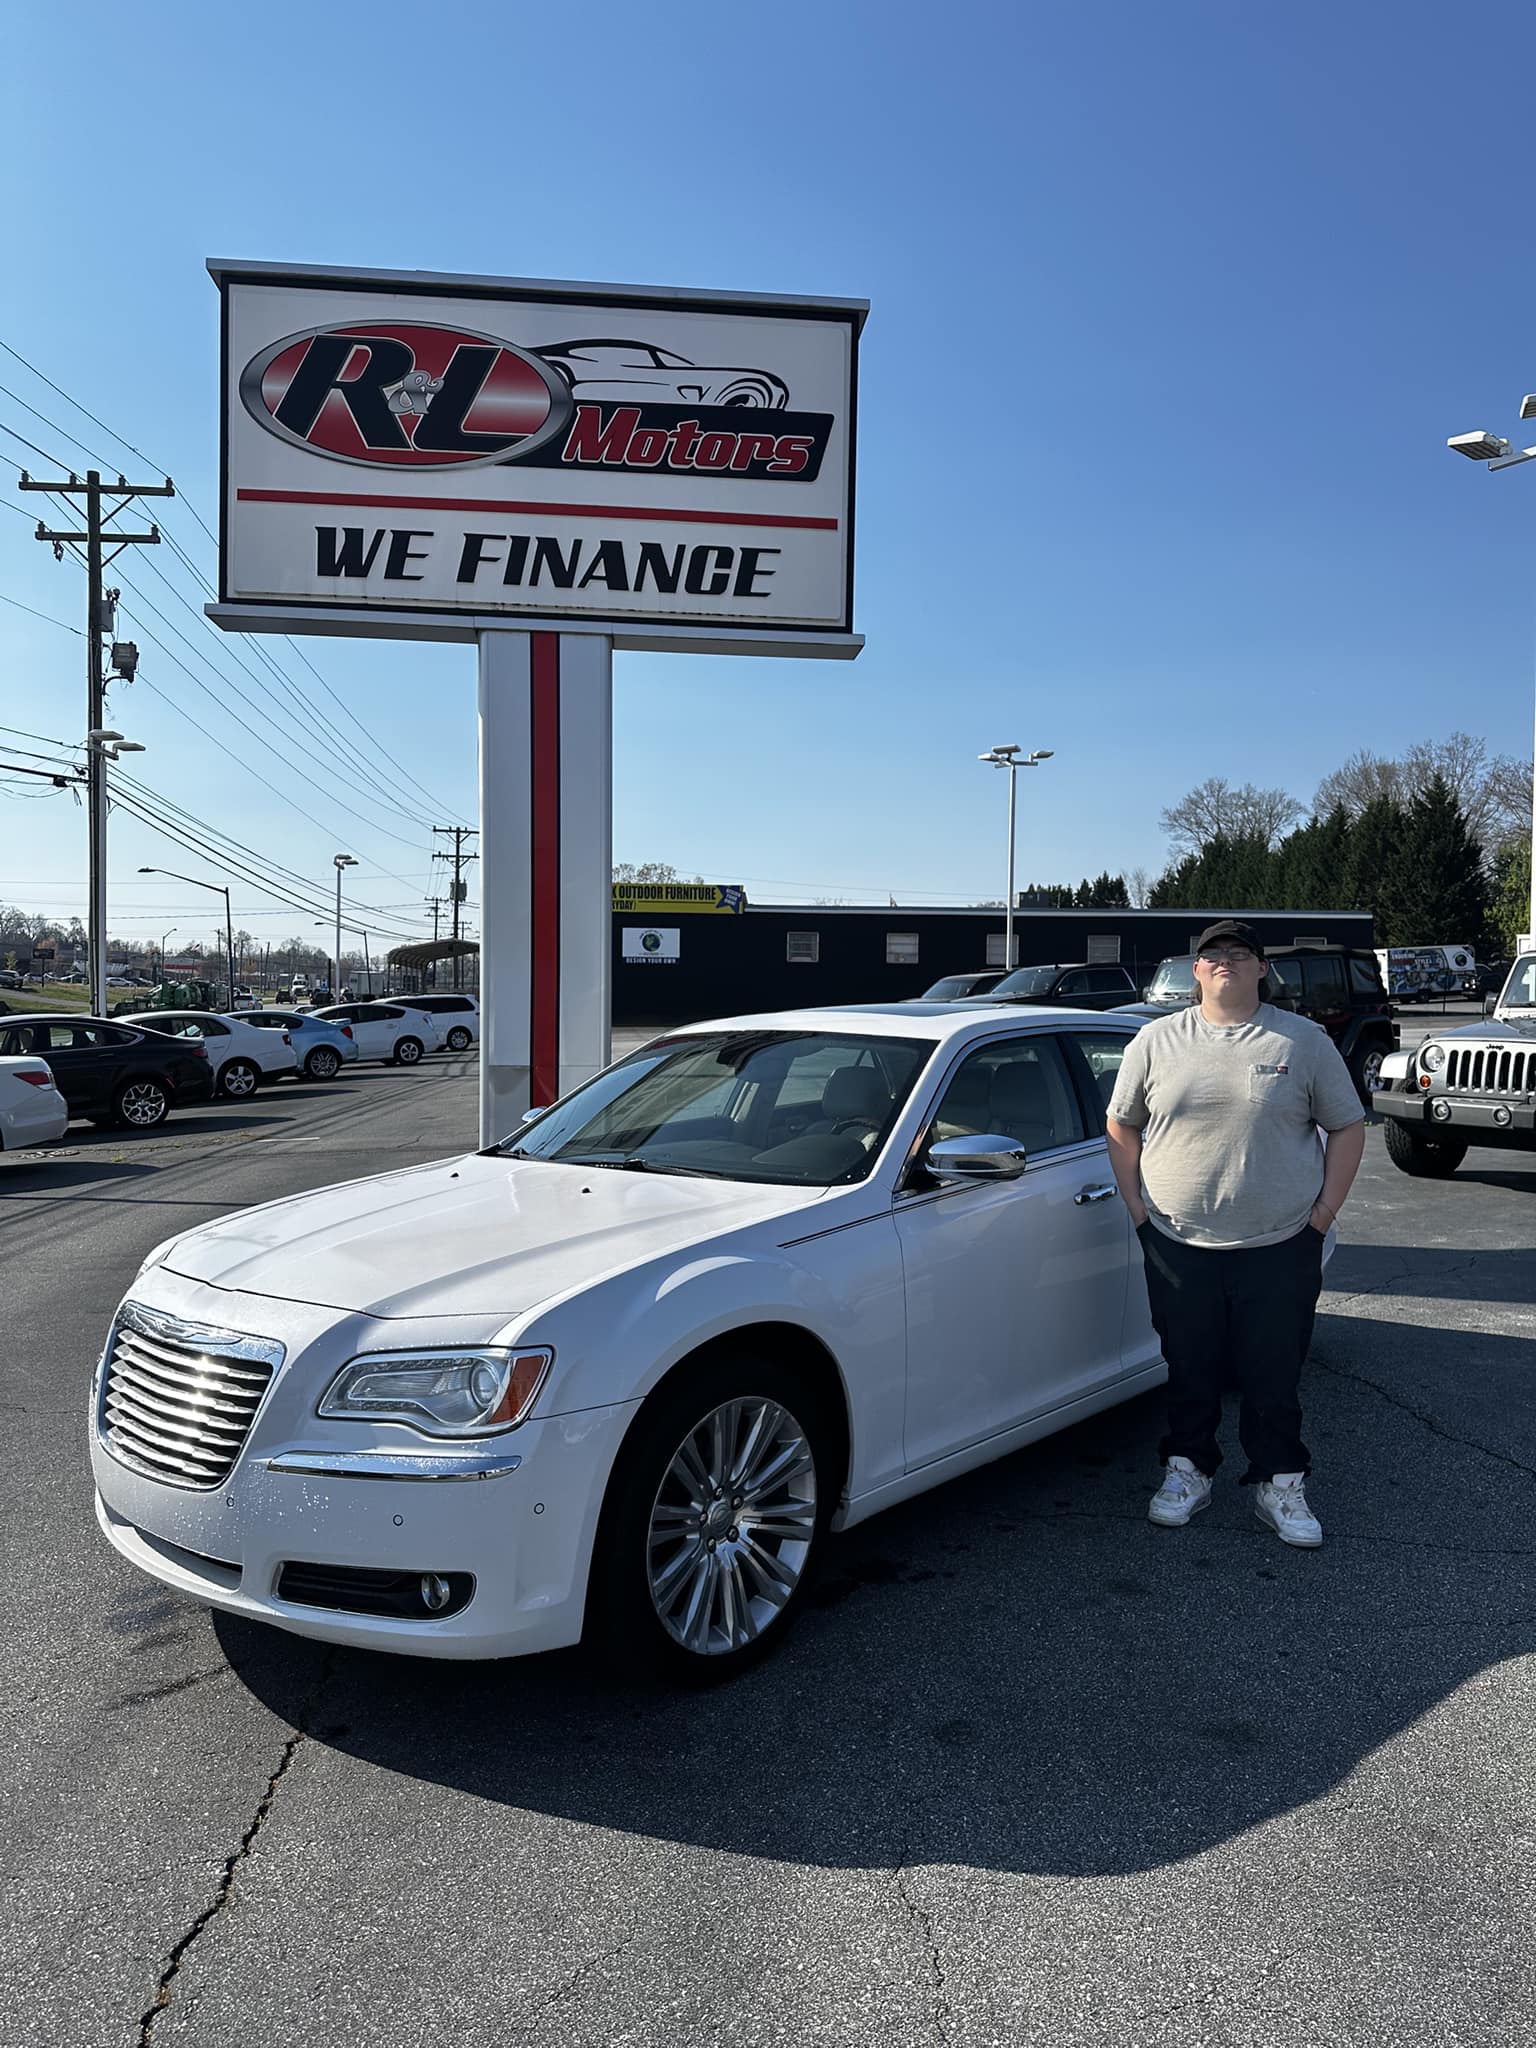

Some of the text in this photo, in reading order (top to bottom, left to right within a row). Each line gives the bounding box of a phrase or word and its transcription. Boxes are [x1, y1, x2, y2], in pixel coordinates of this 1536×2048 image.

[271, 333, 535, 453] R&L
[562, 405, 815, 473] Motors
[314, 525, 783, 598] WE FINANCE
[619, 886, 664, 899] OUTDOOR
[665, 886, 716, 900] FURNITURE
